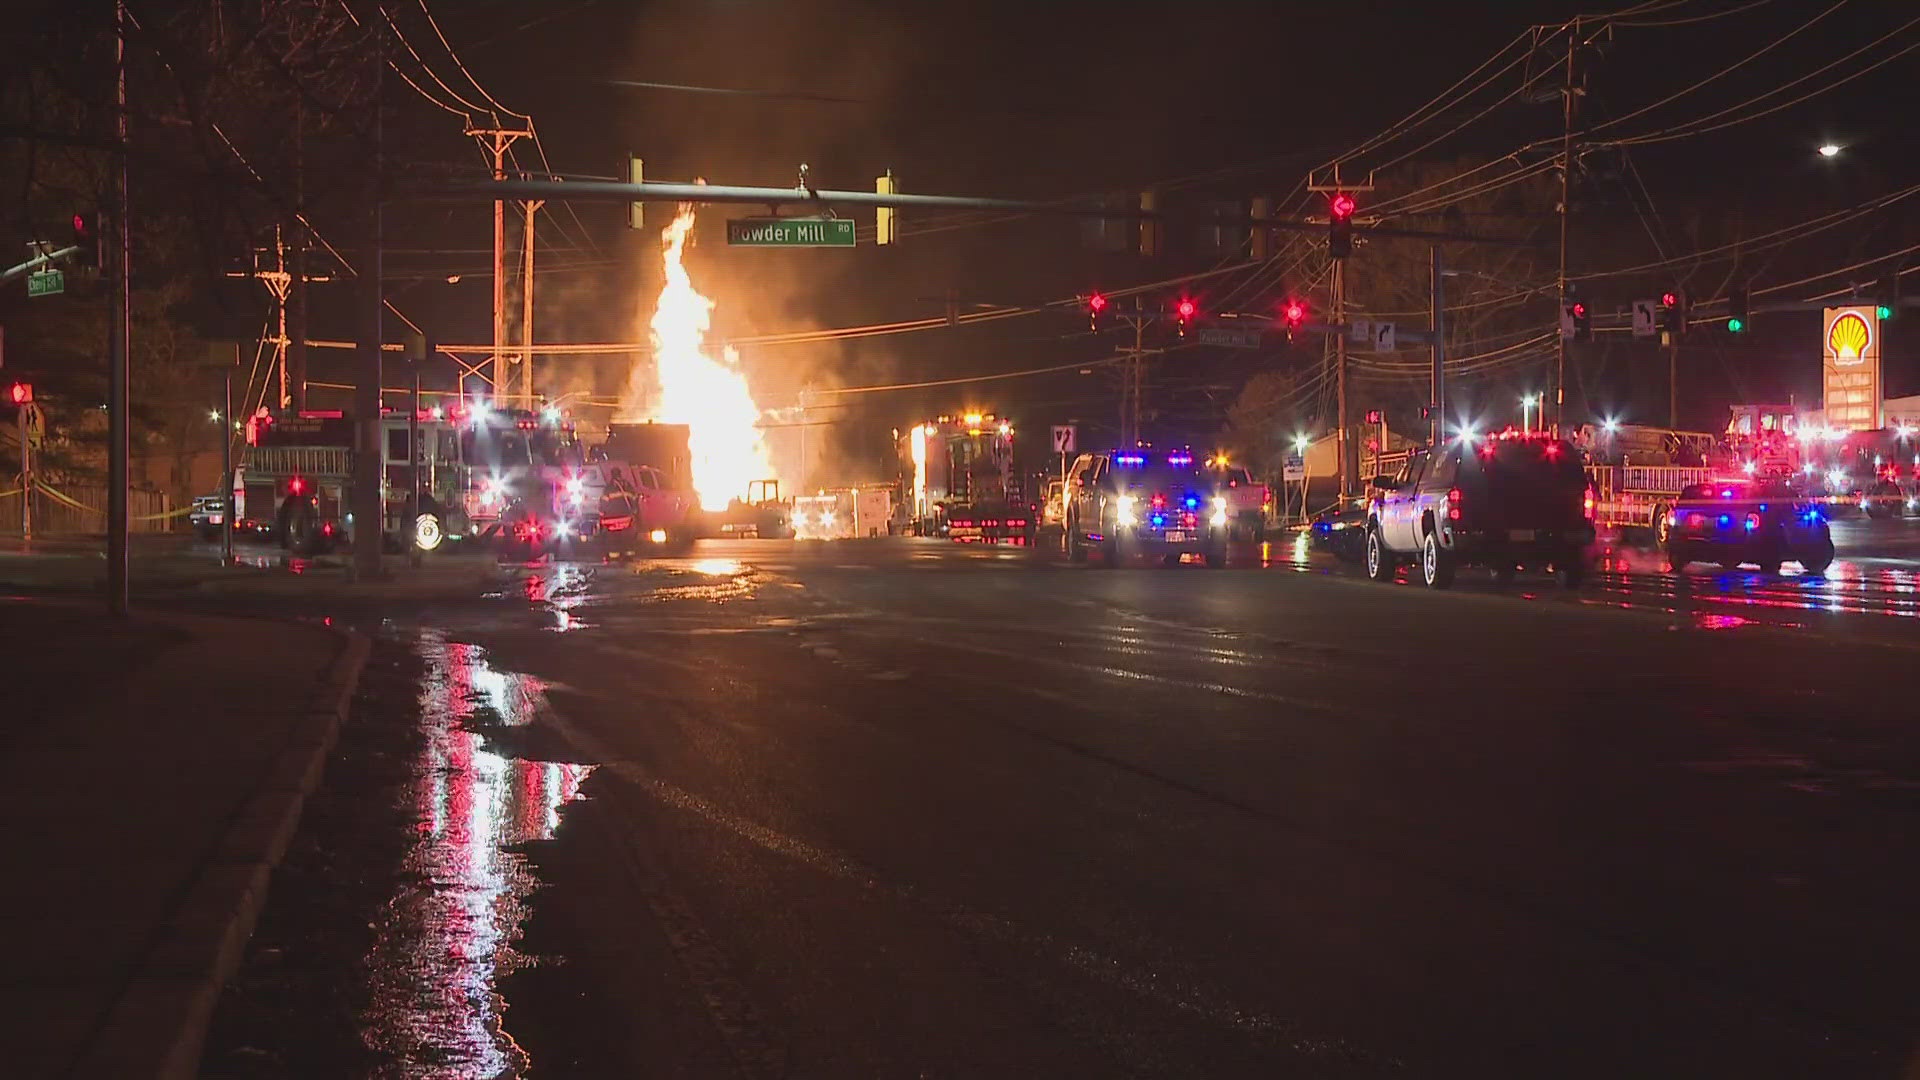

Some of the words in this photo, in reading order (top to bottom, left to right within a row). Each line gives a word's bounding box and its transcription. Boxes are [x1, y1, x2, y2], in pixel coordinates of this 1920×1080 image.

[731, 225, 790, 241] Powder
[797, 224, 825, 242] Mill
[838, 224, 850, 233] RD
